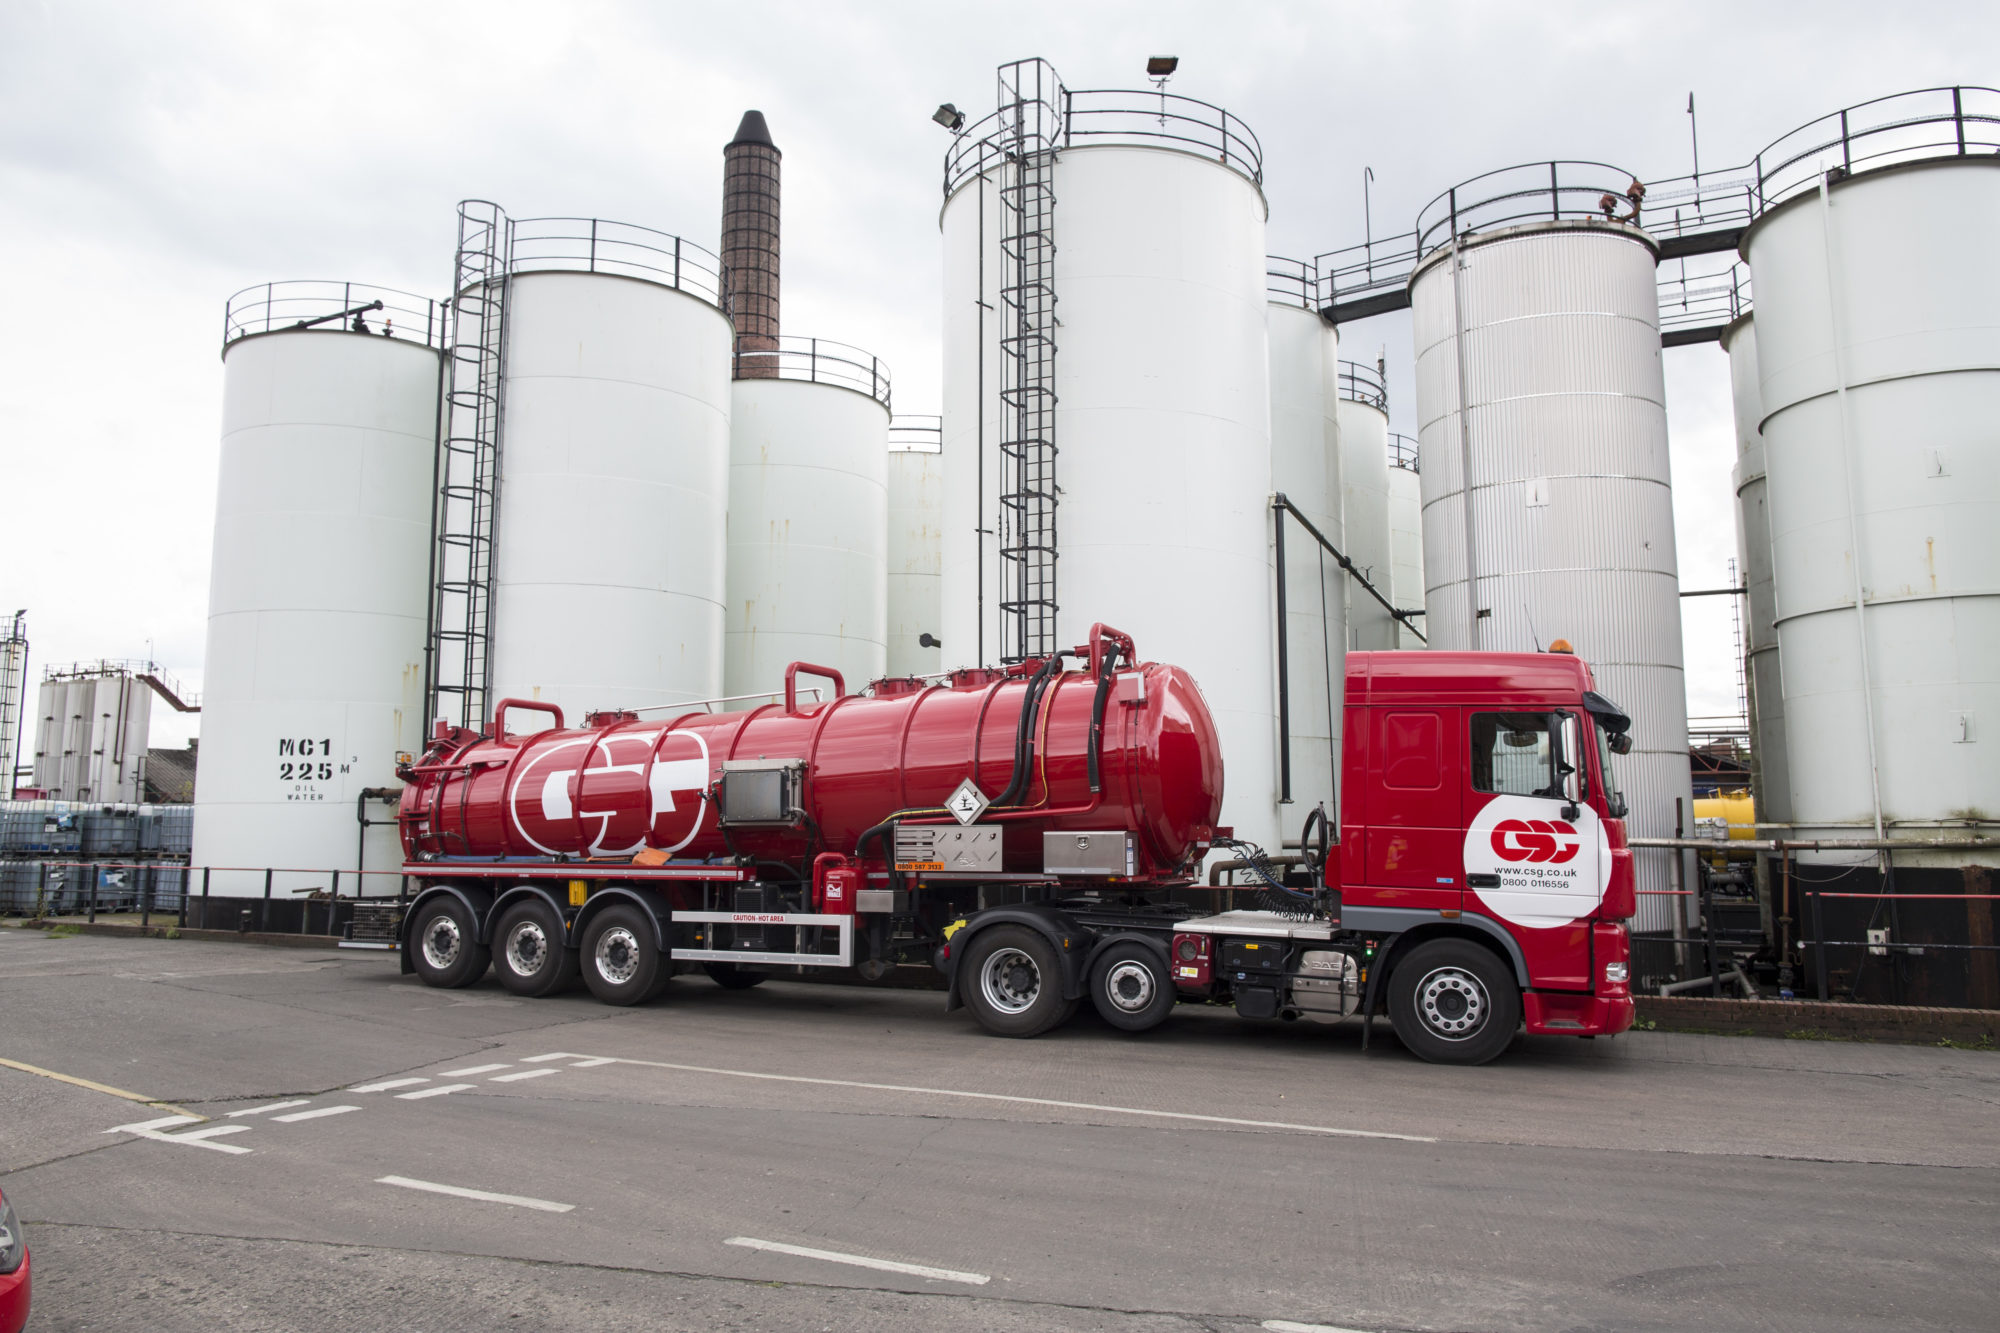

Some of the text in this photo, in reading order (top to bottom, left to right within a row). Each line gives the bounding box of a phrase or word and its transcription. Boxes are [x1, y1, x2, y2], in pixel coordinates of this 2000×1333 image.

[280, 762, 333, 780] 225
[295, 784, 316, 792] OIL
[287, 793, 324, 801] WATER
[1490, 819, 1580, 864] CSG
[1494, 867, 1577, 878] www.csg.co.uk
[1502, 878, 1569, 889] 0800 0116556
